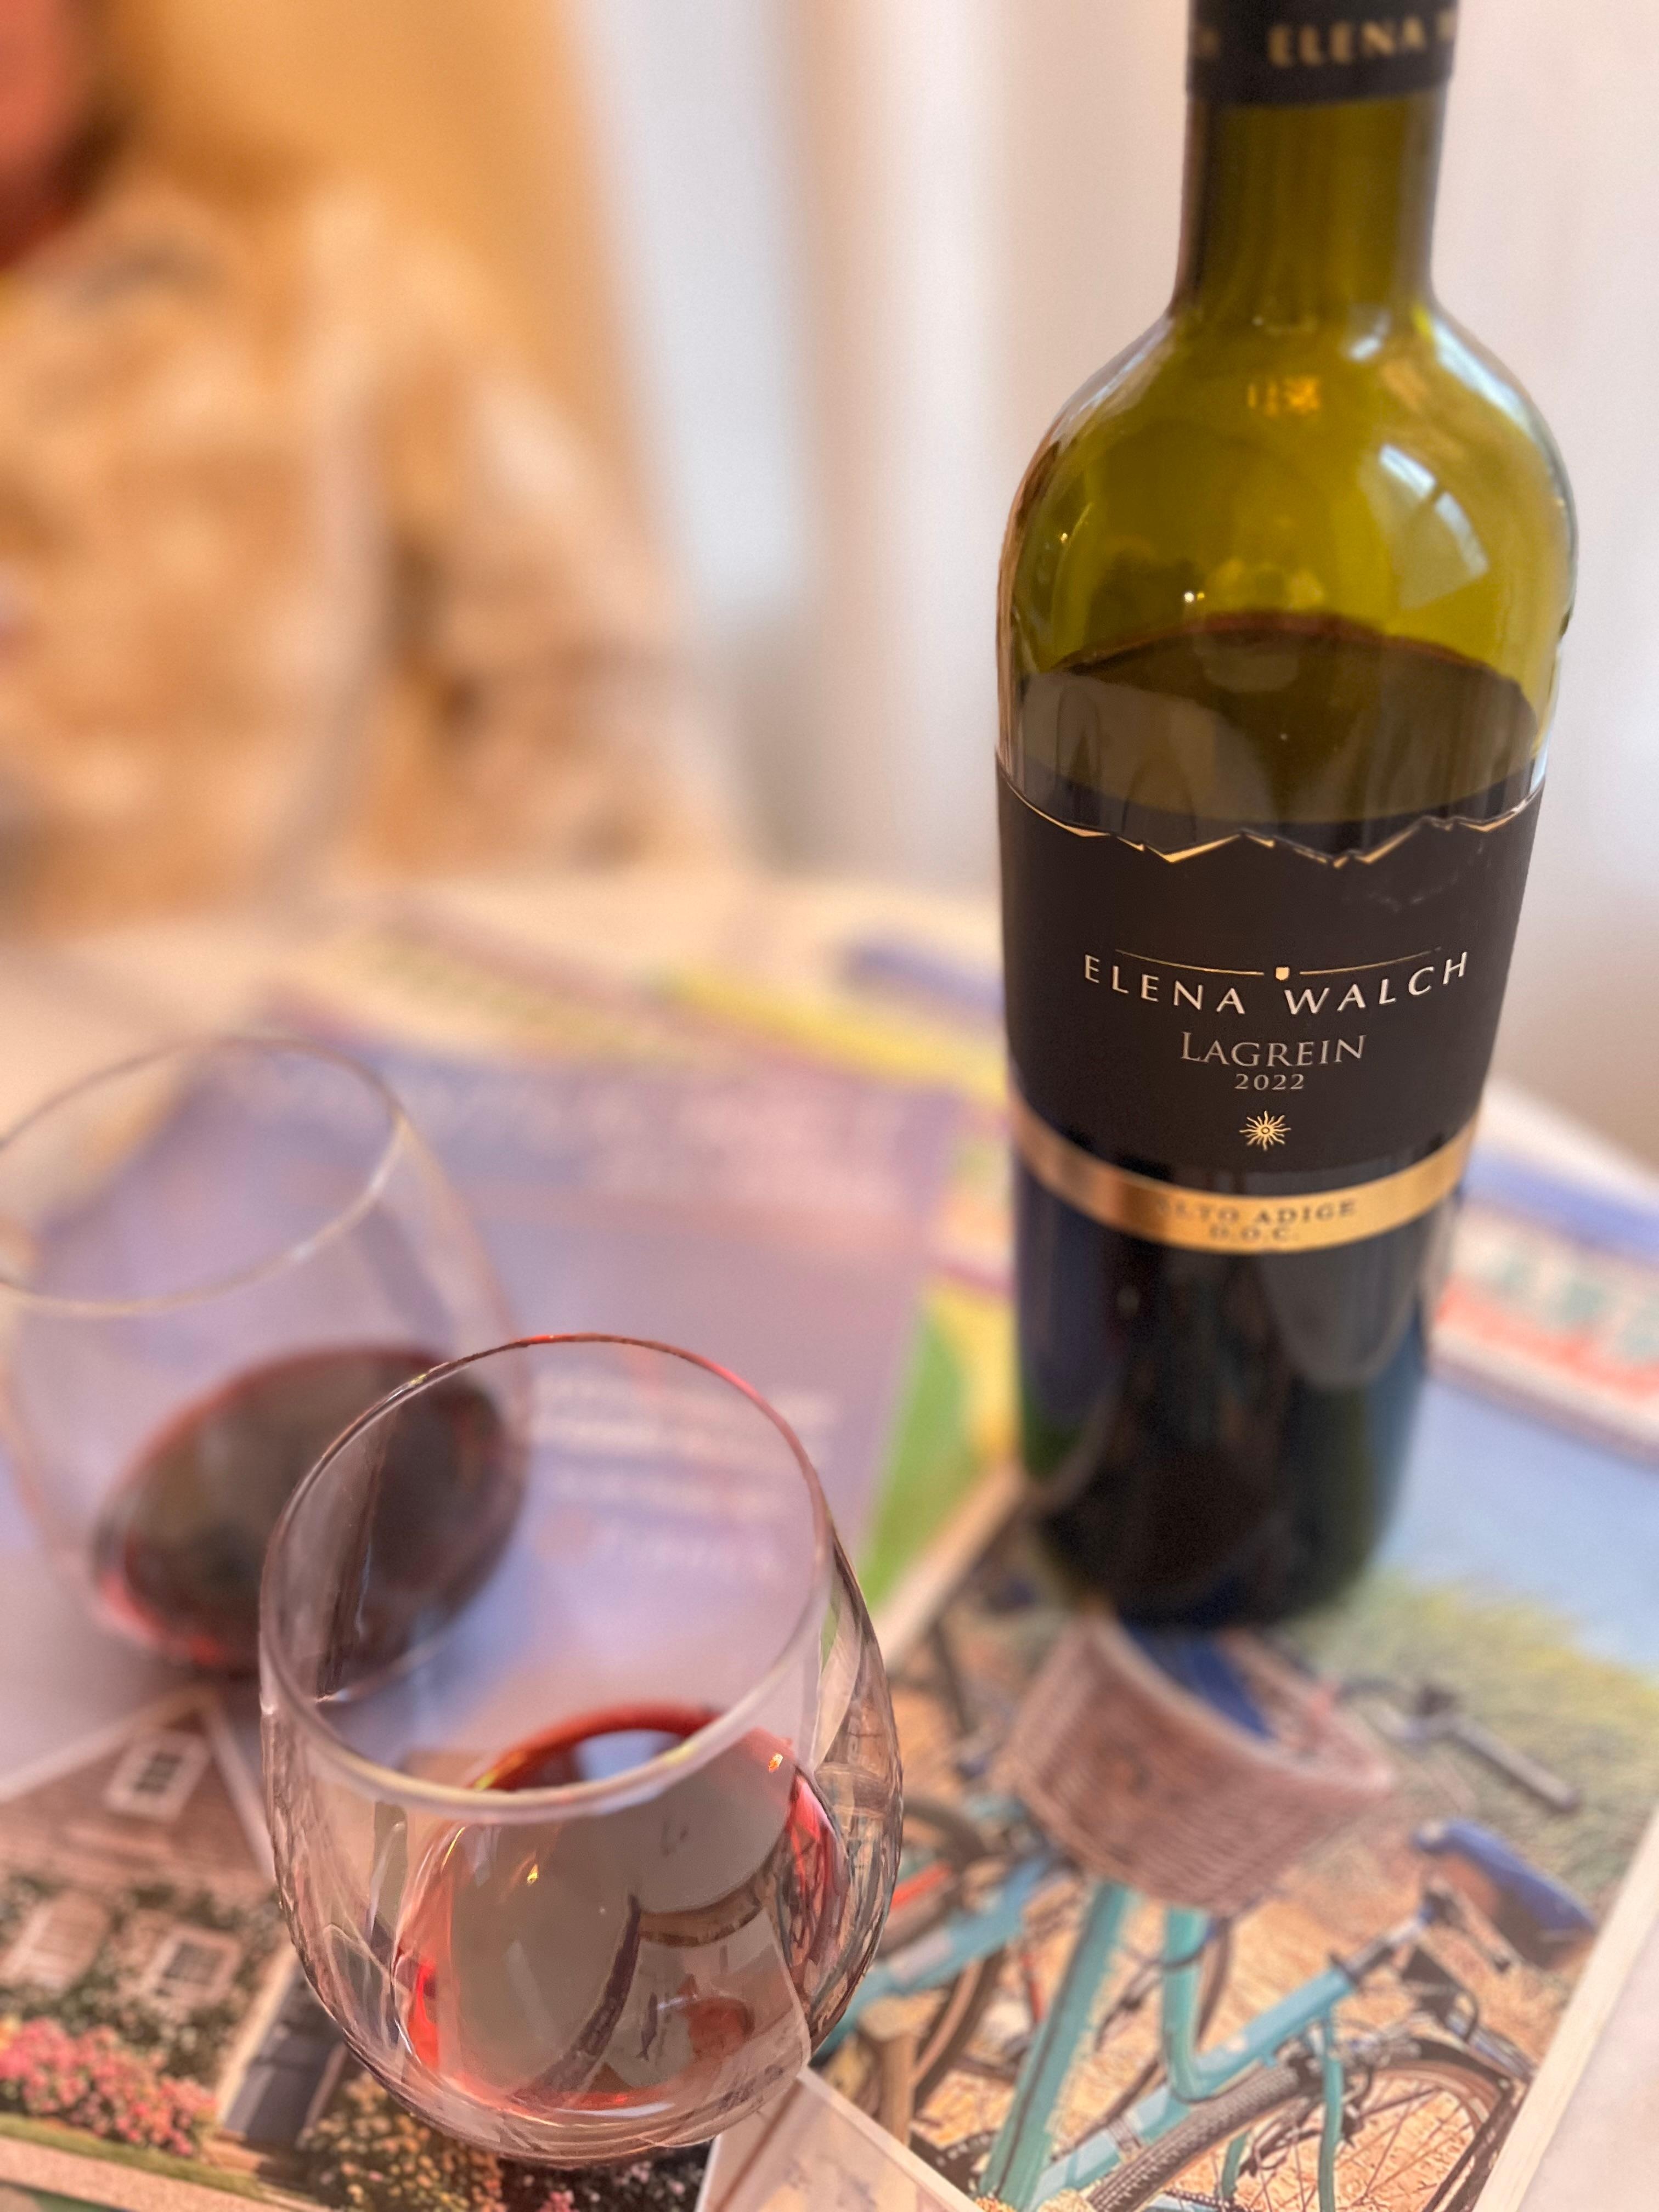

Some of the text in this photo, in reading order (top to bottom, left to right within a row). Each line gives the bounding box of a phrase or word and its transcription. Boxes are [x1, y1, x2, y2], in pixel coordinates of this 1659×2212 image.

[1084, 951, 1468, 1015] ELENA WALCH
[1234, 1073, 1305, 1091] 2022
[1256, 1200, 1356, 1225] ADIGE
